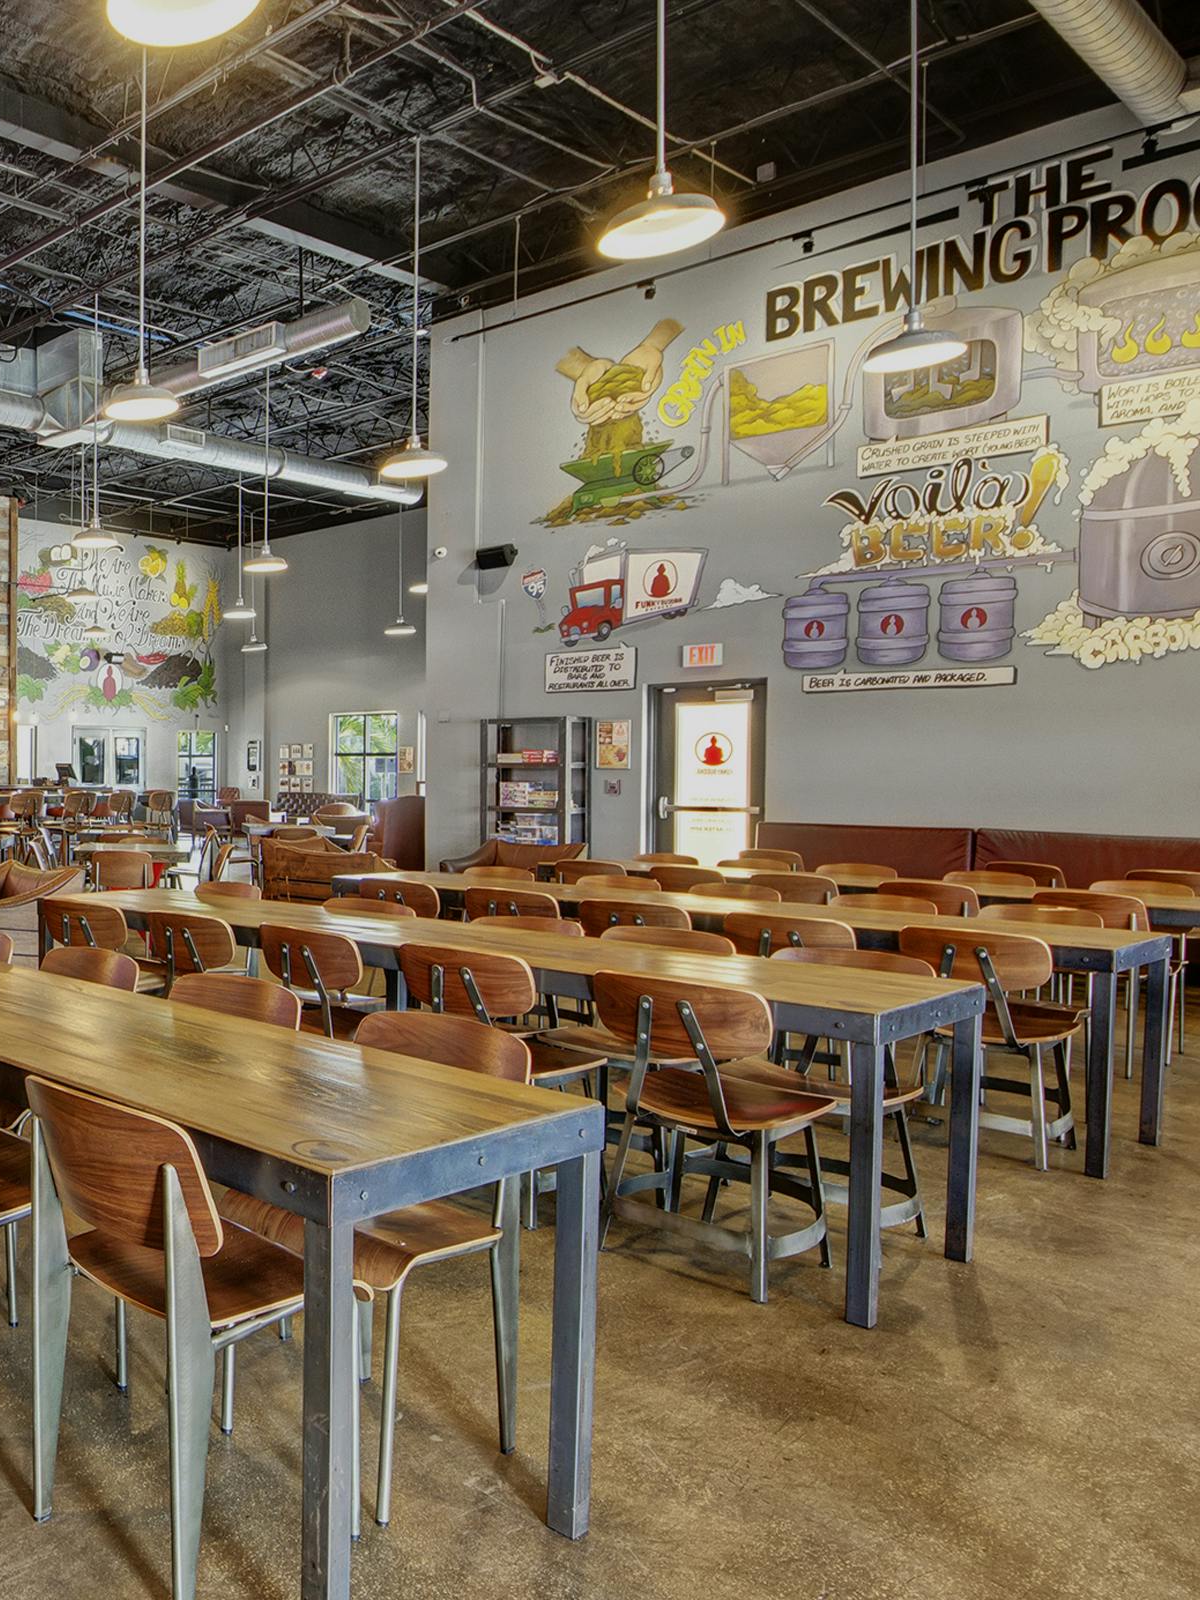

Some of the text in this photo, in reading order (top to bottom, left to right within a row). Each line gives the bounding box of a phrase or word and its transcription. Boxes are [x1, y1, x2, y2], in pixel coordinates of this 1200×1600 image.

[967, 148, 1113, 228] THE
[766, 178, 1200, 342] BREWING PRO
[658, 320, 746, 427] GRAIN IN
[1145, 383, 1159, 394] IS
[1106, 399, 1134, 410] WITH
[1158, 401, 1185, 412] AND
[861, 424, 1040, 461] CRUSHED GRAIN IS STEEPED WITH
[862, 460, 891, 472] WATER
[897, 457, 909, 466] TO
[912, 451, 948, 464] CREATE
[952, 446, 980, 459] WORT
[528, 581, 544, 597] 95
[17, 609, 42, 637] The
[549, 653, 625, 667] FINISHED BEER IS
[689, 645, 716, 665] EXIT
[553, 662, 621, 673] DISTRIBUTED TO
[567, 672, 605, 681] BARS AND
[809, 677, 834, 688] BEER
[839, 677, 851, 687] IS
[854, 675, 910, 686] CARBONATED
[913, 674, 931, 684] AND
[548, 681, 595, 690] RESTAURANTS
[596, 680, 608, 688] ALL
